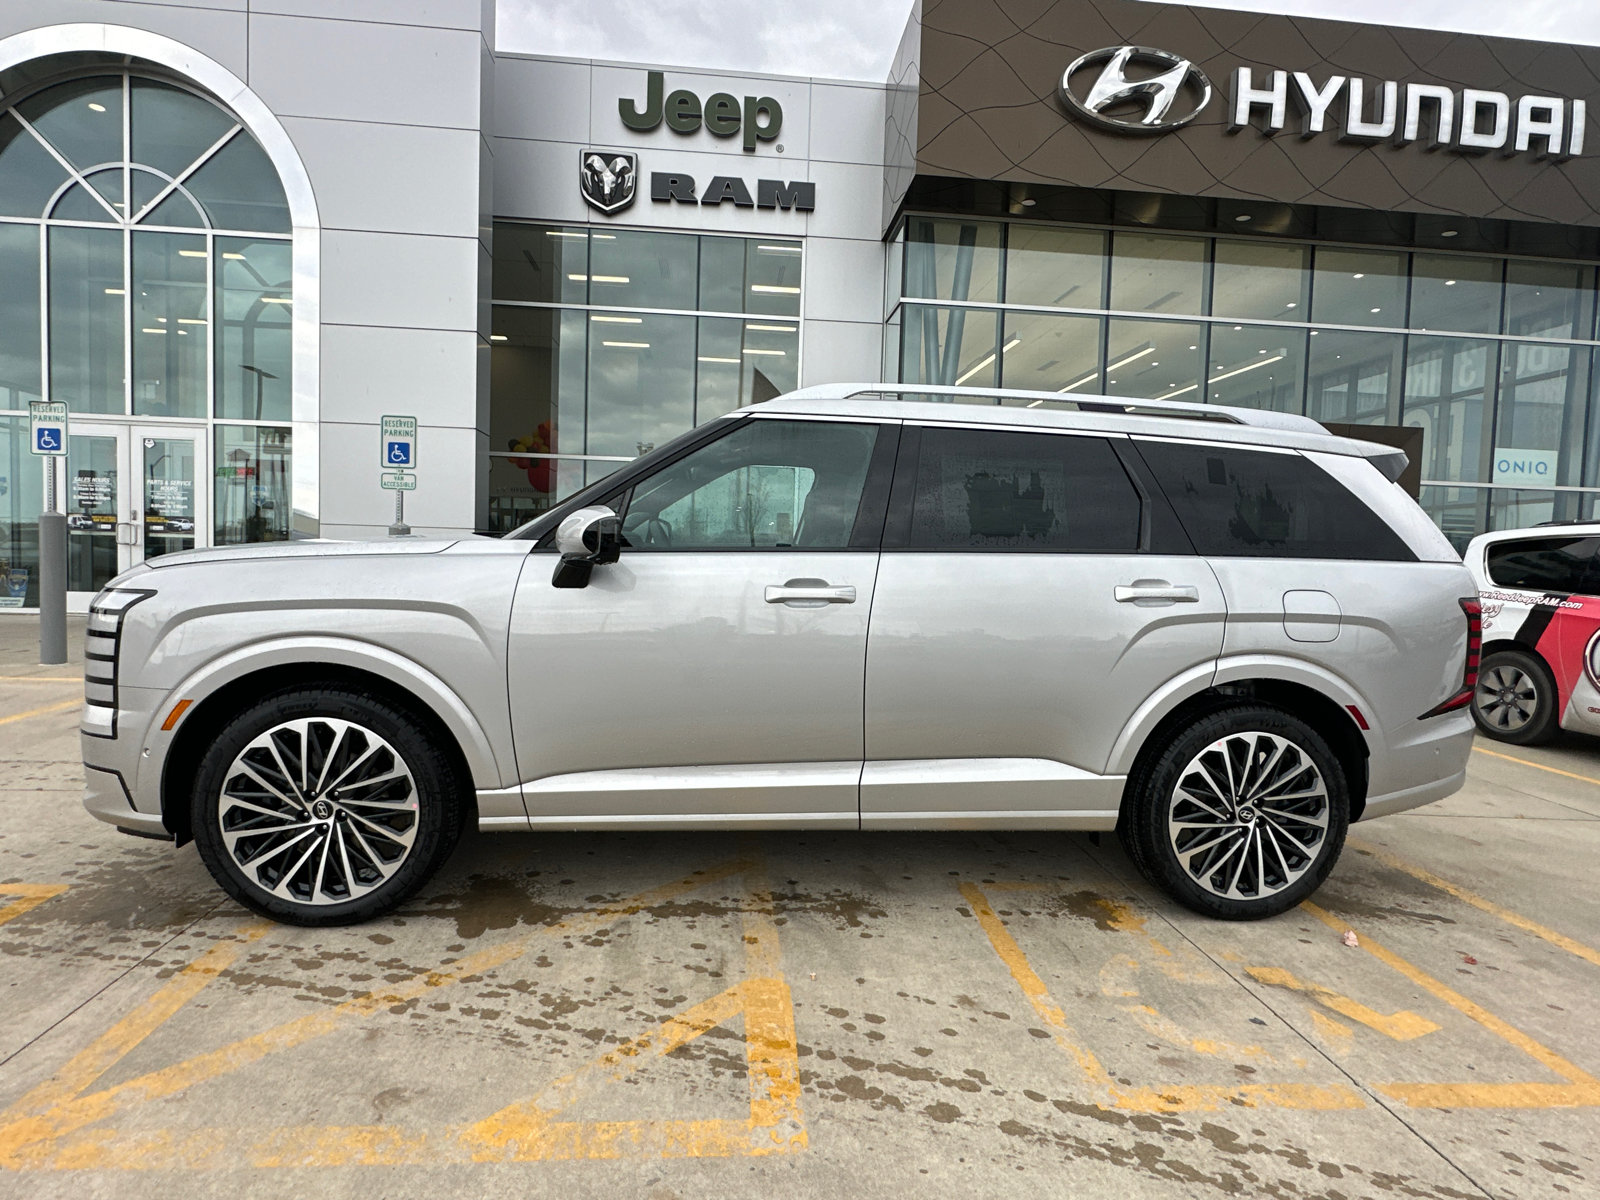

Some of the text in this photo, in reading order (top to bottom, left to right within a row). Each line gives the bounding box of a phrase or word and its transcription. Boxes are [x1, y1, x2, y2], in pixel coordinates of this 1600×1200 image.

[618, 70, 783, 152] Jeep
[1230, 66, 1586, 157] HYUNDAI
[650, 171, 816, 212] RAM
[32, 404, 65, 414] RESERVED
[32, 414, 65, 423] PARKING
[384, 419, 414, 429] RESERVED
[383, 429, 414, 438] PARKING
